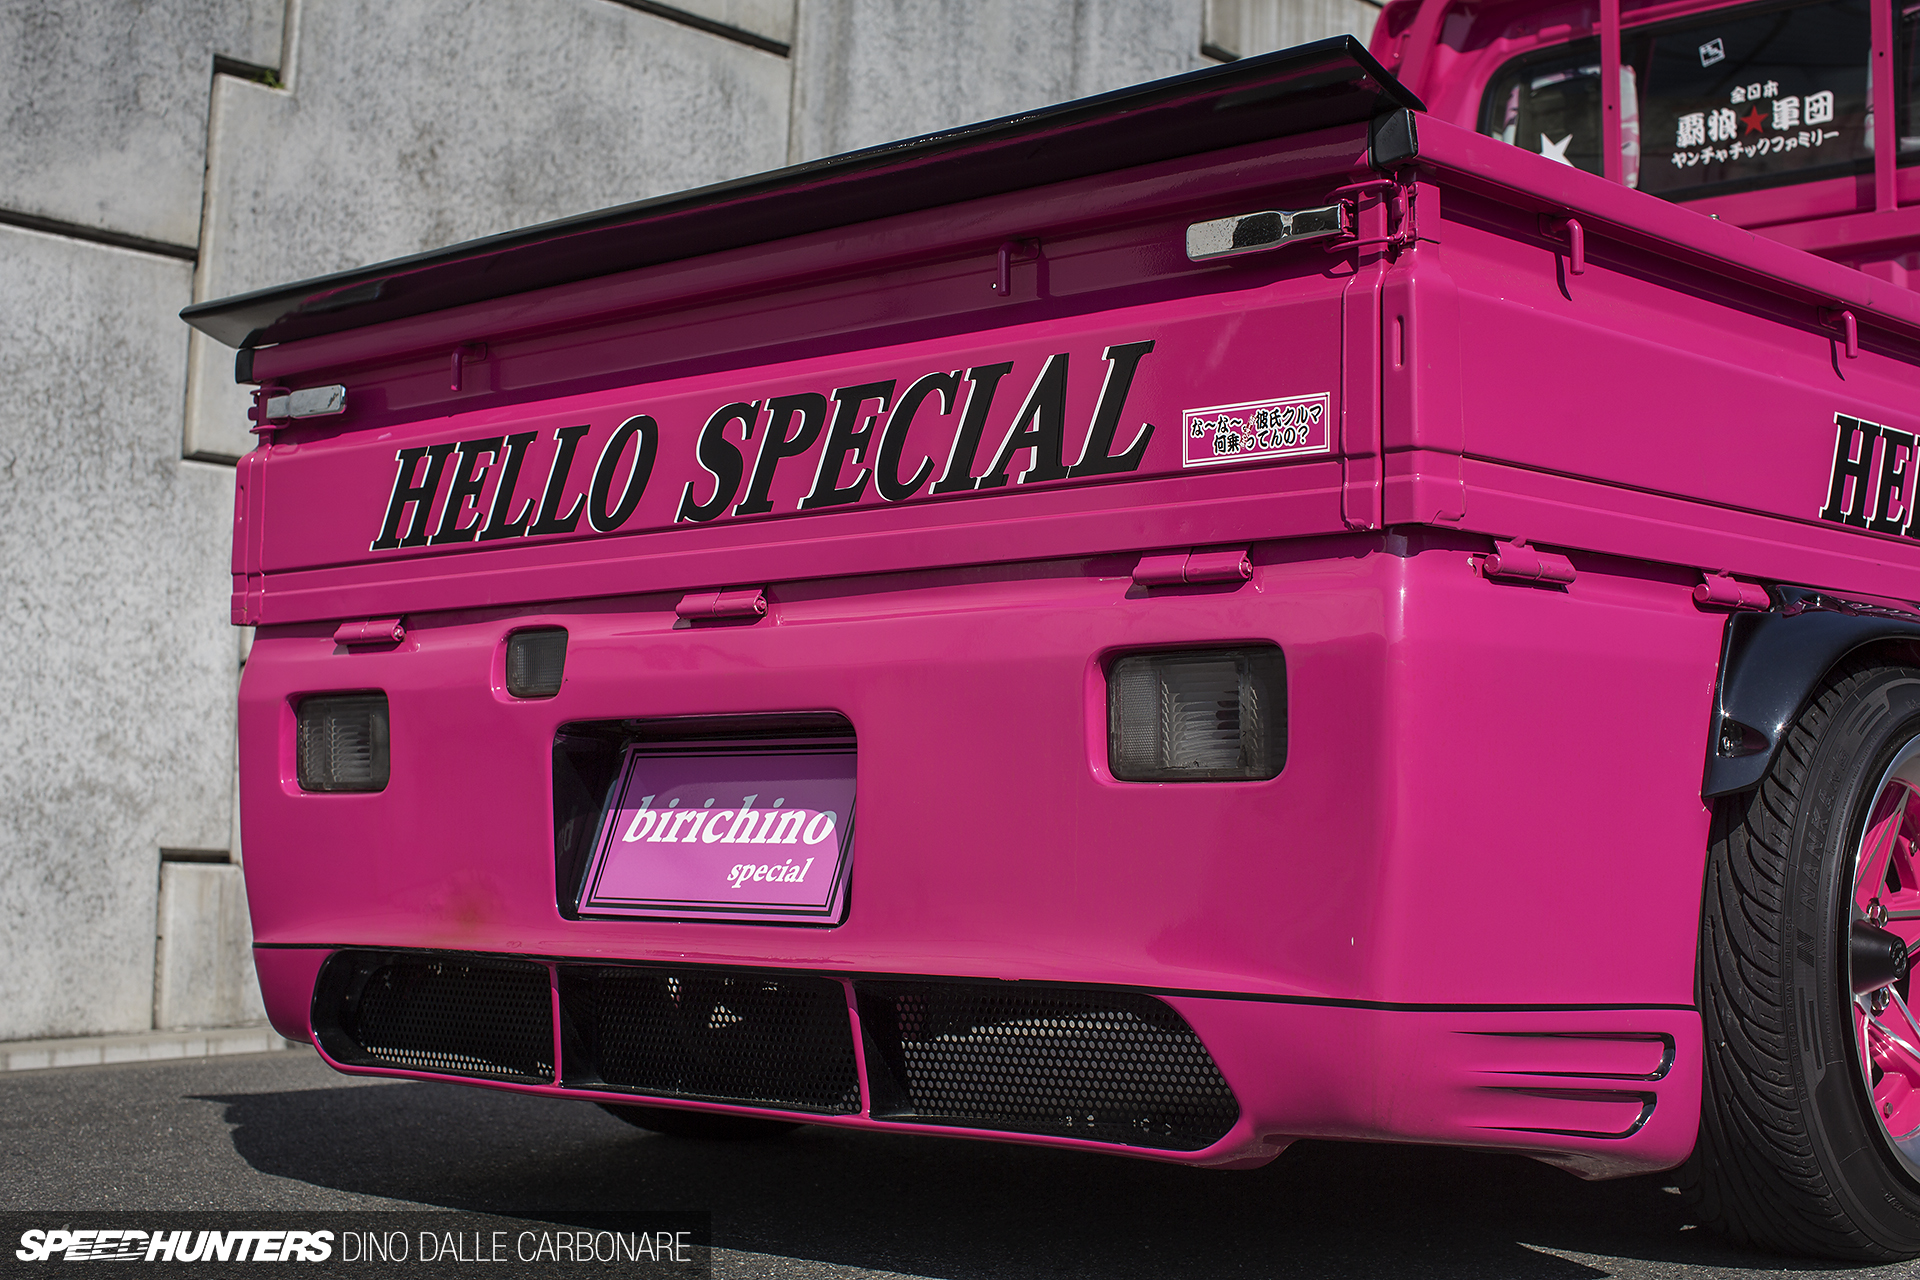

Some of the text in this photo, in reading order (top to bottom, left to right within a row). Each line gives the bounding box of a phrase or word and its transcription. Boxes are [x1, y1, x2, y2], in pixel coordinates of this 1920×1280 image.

[1730, 80, 1779, 104] 全日本
[1671, 128, 1840, 169] ヤンチャチックファミリー
[369, 339, 1156, 552] HELLO SPECIAL
[622, 794, 838, 846] birichino
[1801, 749, 1850, 911] NANKANG
[726, 857, 815, 889] special
[1784, 916, 1793, 970] TUBELESS
[1785, 981, 1795, 1016] RADIAL
